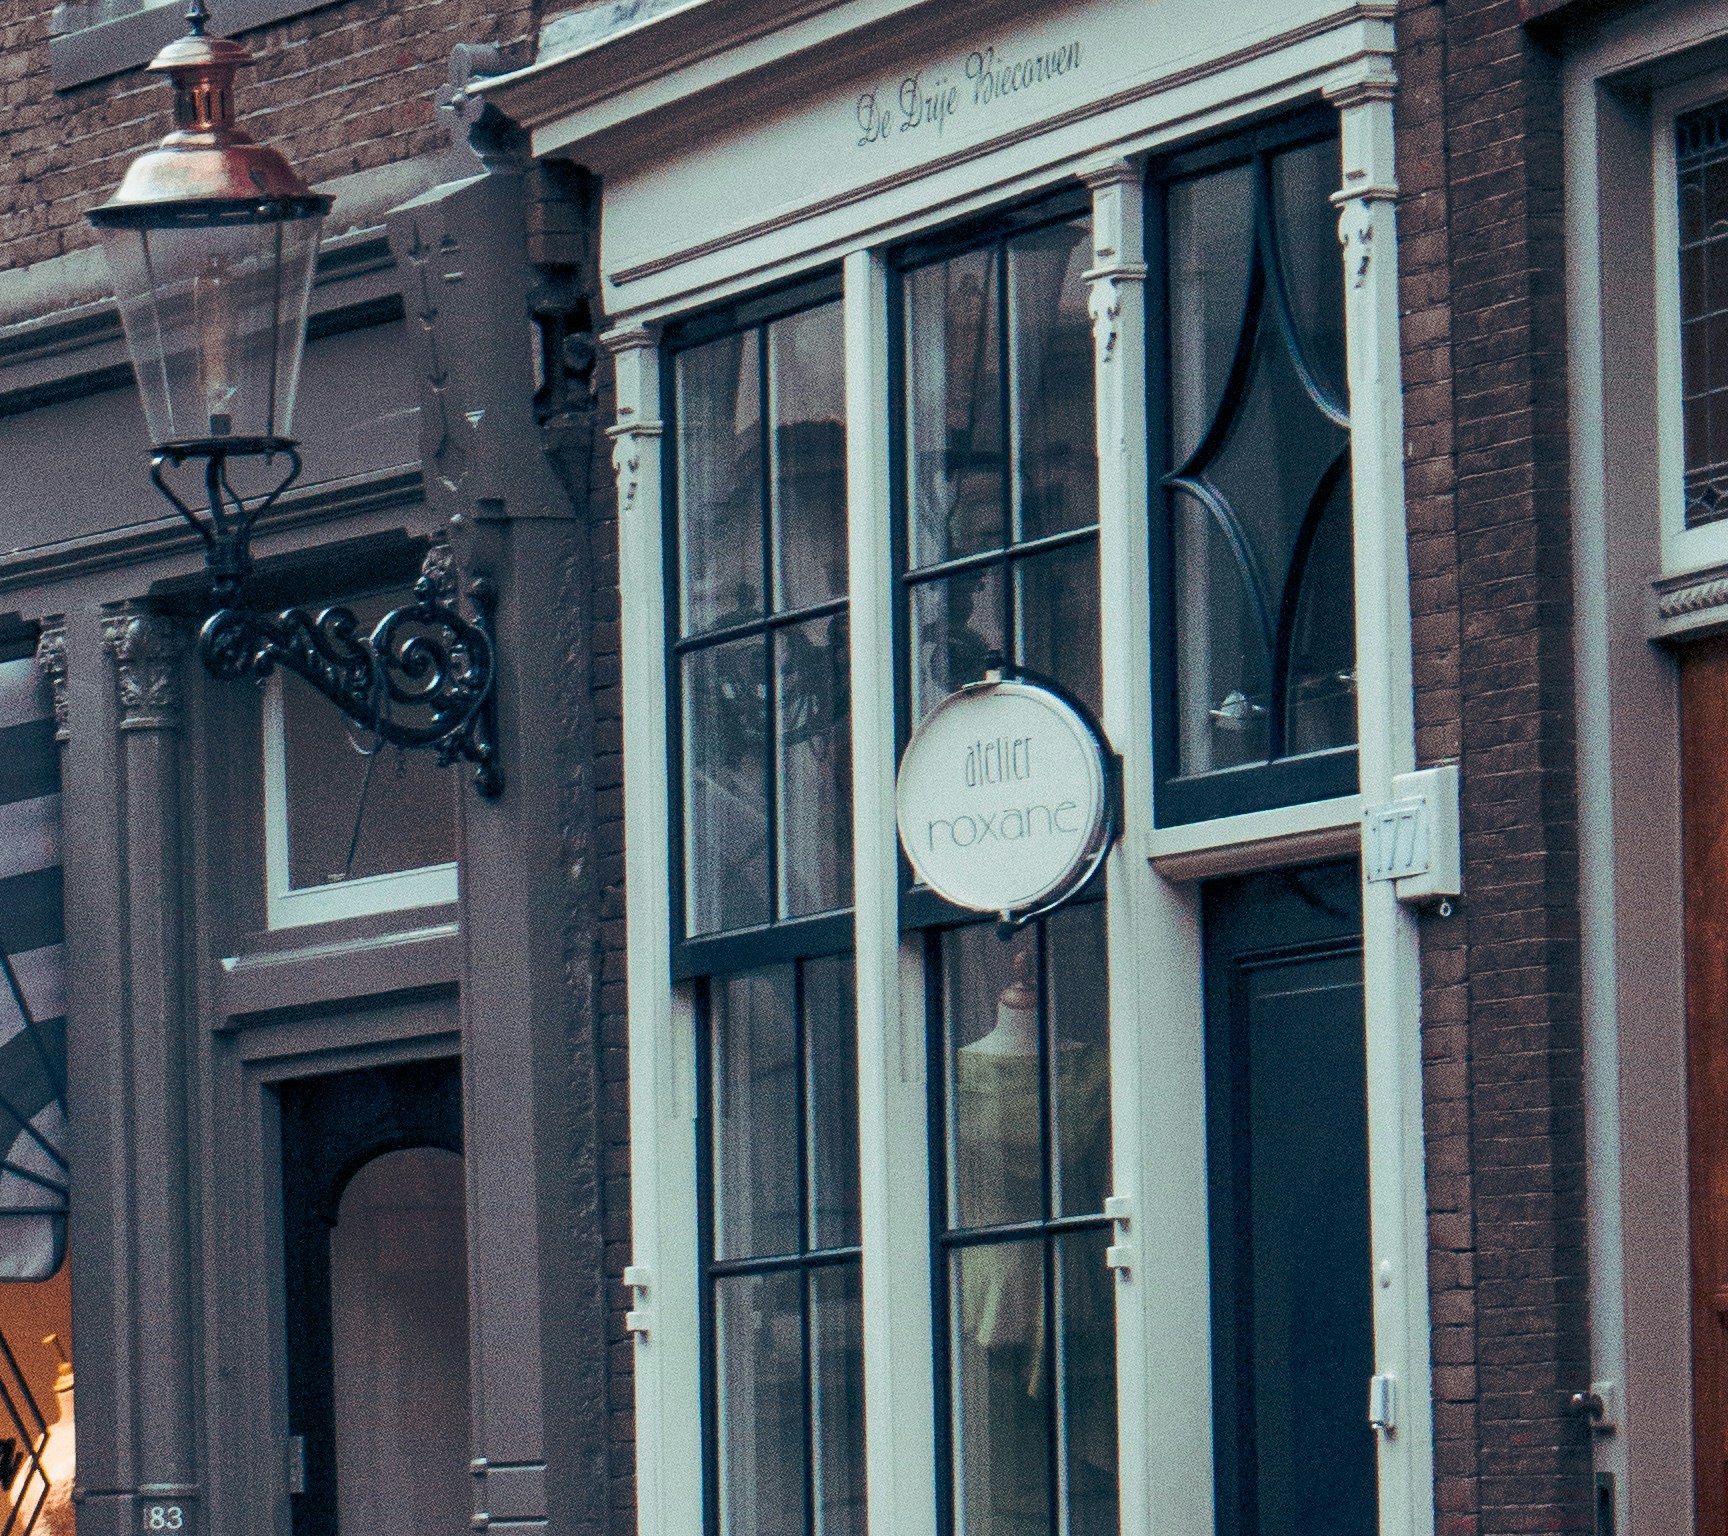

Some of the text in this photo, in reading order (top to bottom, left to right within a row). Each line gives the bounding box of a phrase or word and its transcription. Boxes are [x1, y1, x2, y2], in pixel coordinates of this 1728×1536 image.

[856, 86, 892, 146] De
[965, 735, 1033, 787] atelier
[928, 800, 1078, 852] roxane
